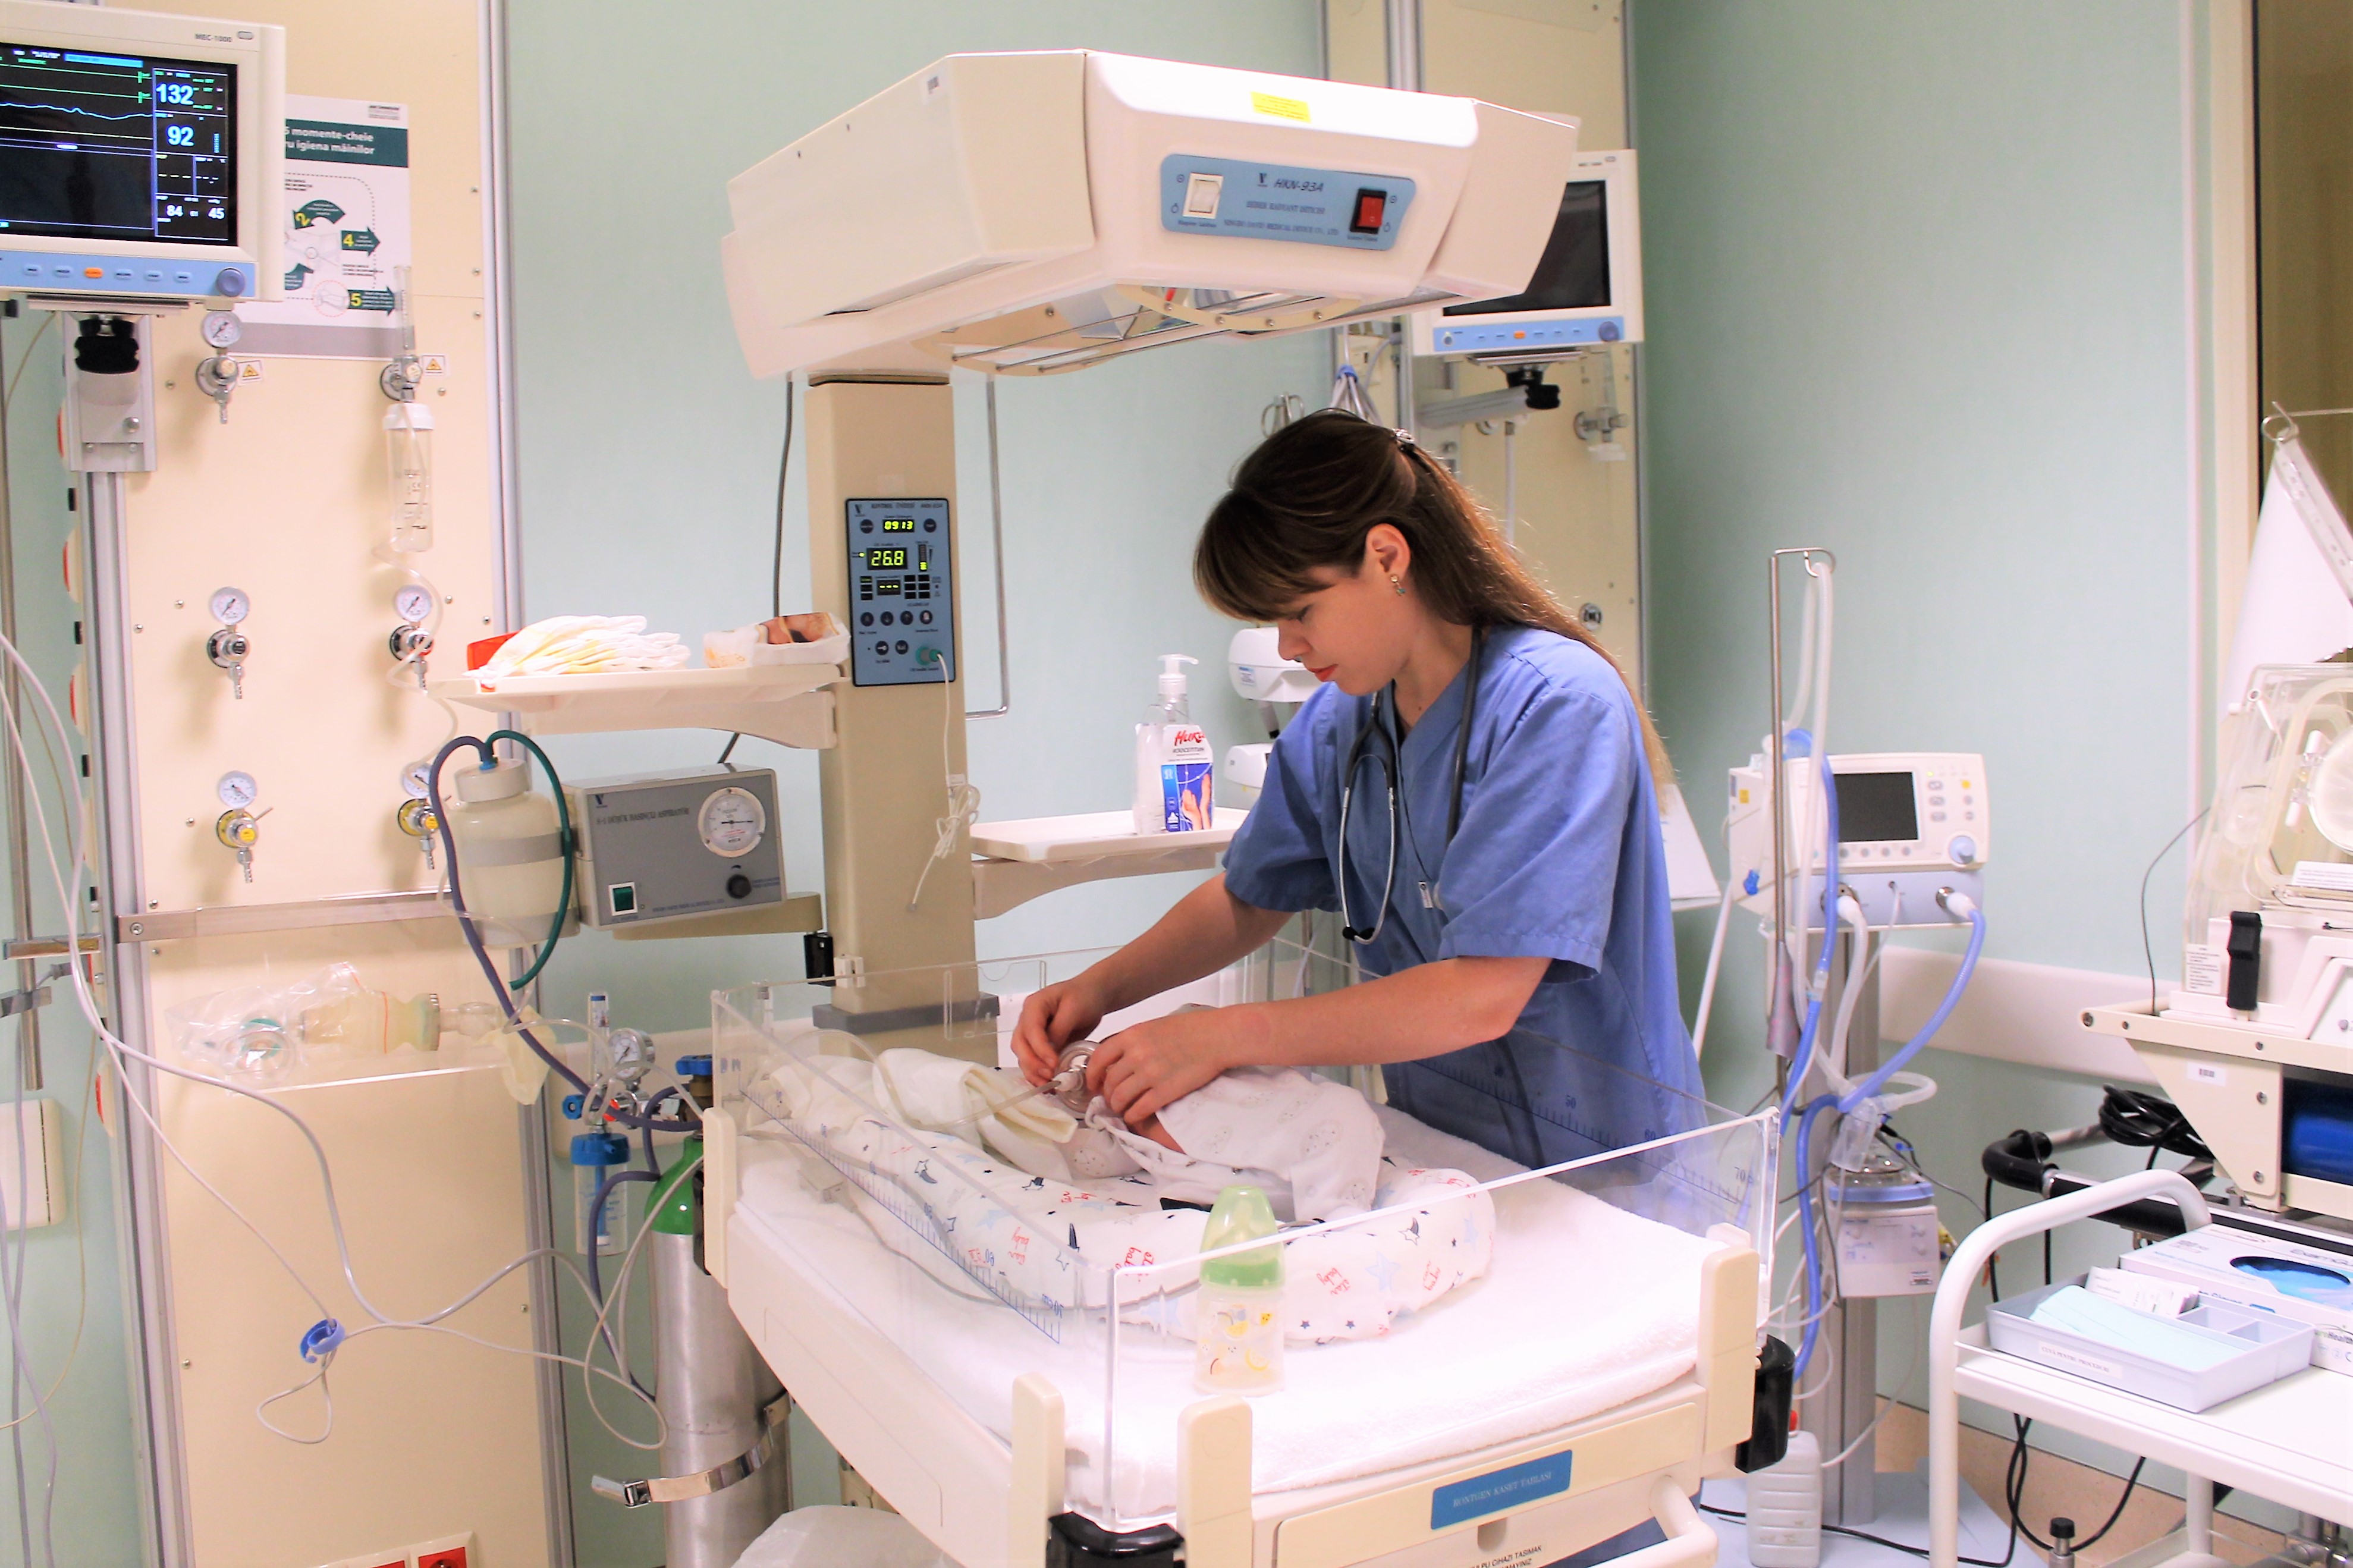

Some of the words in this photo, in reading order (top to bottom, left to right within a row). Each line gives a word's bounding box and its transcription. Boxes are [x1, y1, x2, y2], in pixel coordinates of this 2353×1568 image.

[156, 83, 194, 105] 132
[167, 125, 195, 147] 92
[296, 140, 329, 152] igiena
[1274, 178, 1324, 192] HKN-93A
[166, 204, 184, 218] 84
[208, 207, 225, 219] 45
[294, 212, 312, 227] 2
[343, 233, 354, 247] 4
[350, 292, 362, 307] 5
[884, 520, 914, 530] 0913
[871, 550, 905, 566] 26.8
[1566, 1095, 1576, 1109] 50
[1734, 1166, 1746, 1182] 70
